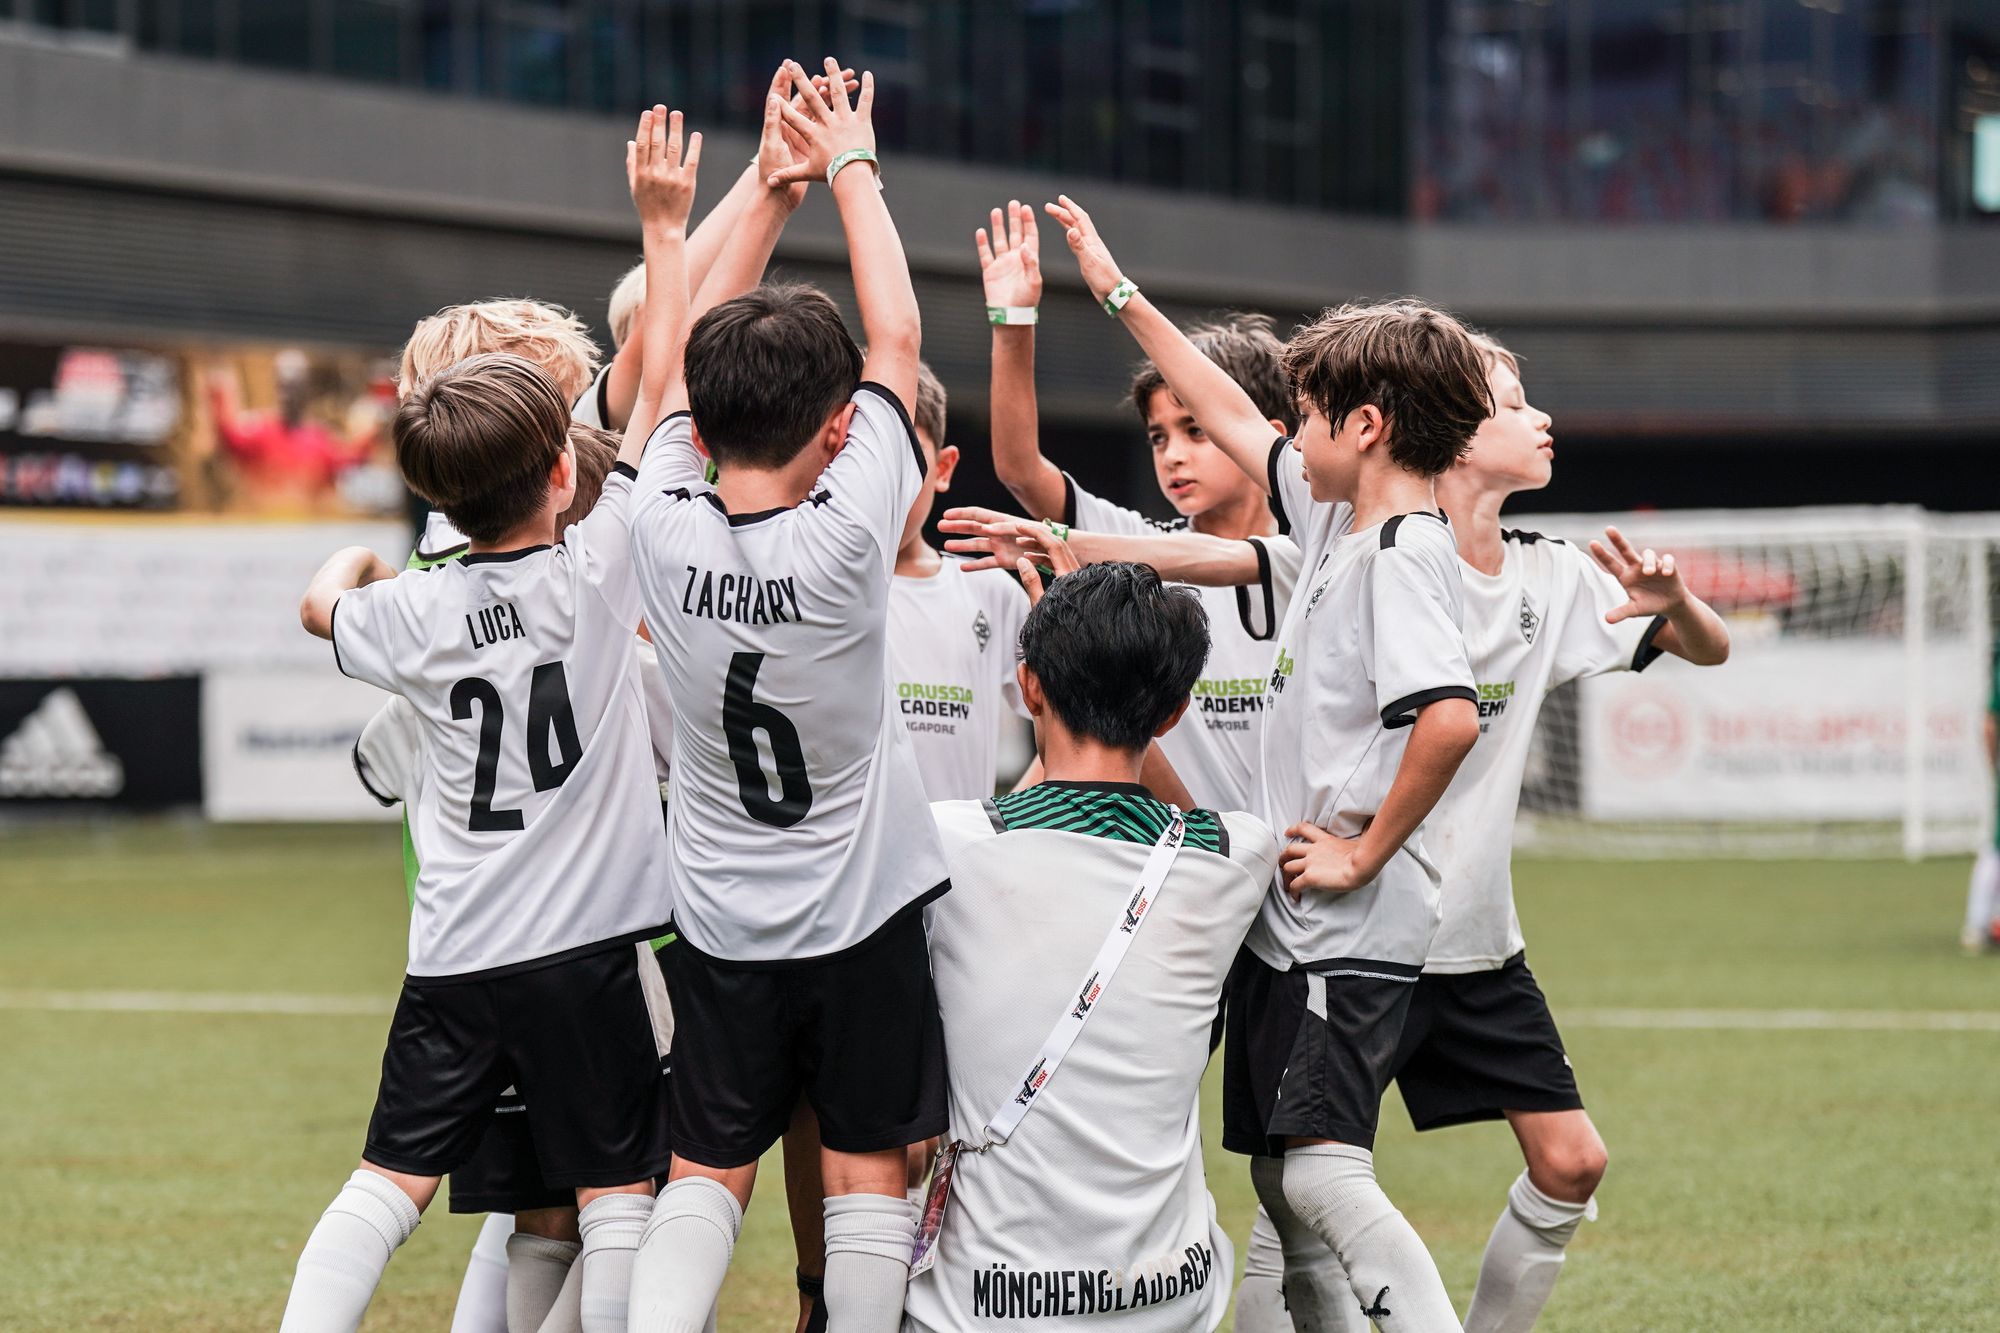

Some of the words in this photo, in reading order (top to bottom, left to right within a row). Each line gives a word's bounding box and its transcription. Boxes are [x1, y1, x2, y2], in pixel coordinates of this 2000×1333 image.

[682, 566, 803, 625] ZACHARY
[466, 602, 526, 650] LUCA
[898, 682, 973, 704] ORUSSIA
[1193, 678, 1268, 696] ORUSSI
[1477, 681, 1515, 700] SSIA
[900, 699, 969, 720] CADEMY
[1195, 696, 1264, 713] ADEMY
[906, 721, 956, 735] GAPORE
[449, 660, 583, 831] 24
[722, 652, 813, 828] 6
[1135, 898, 1148, 916] JSSL
[1087, 983, 1101, 1002] JSSL
[1032, 1070, 1048, 1088] JSSL
